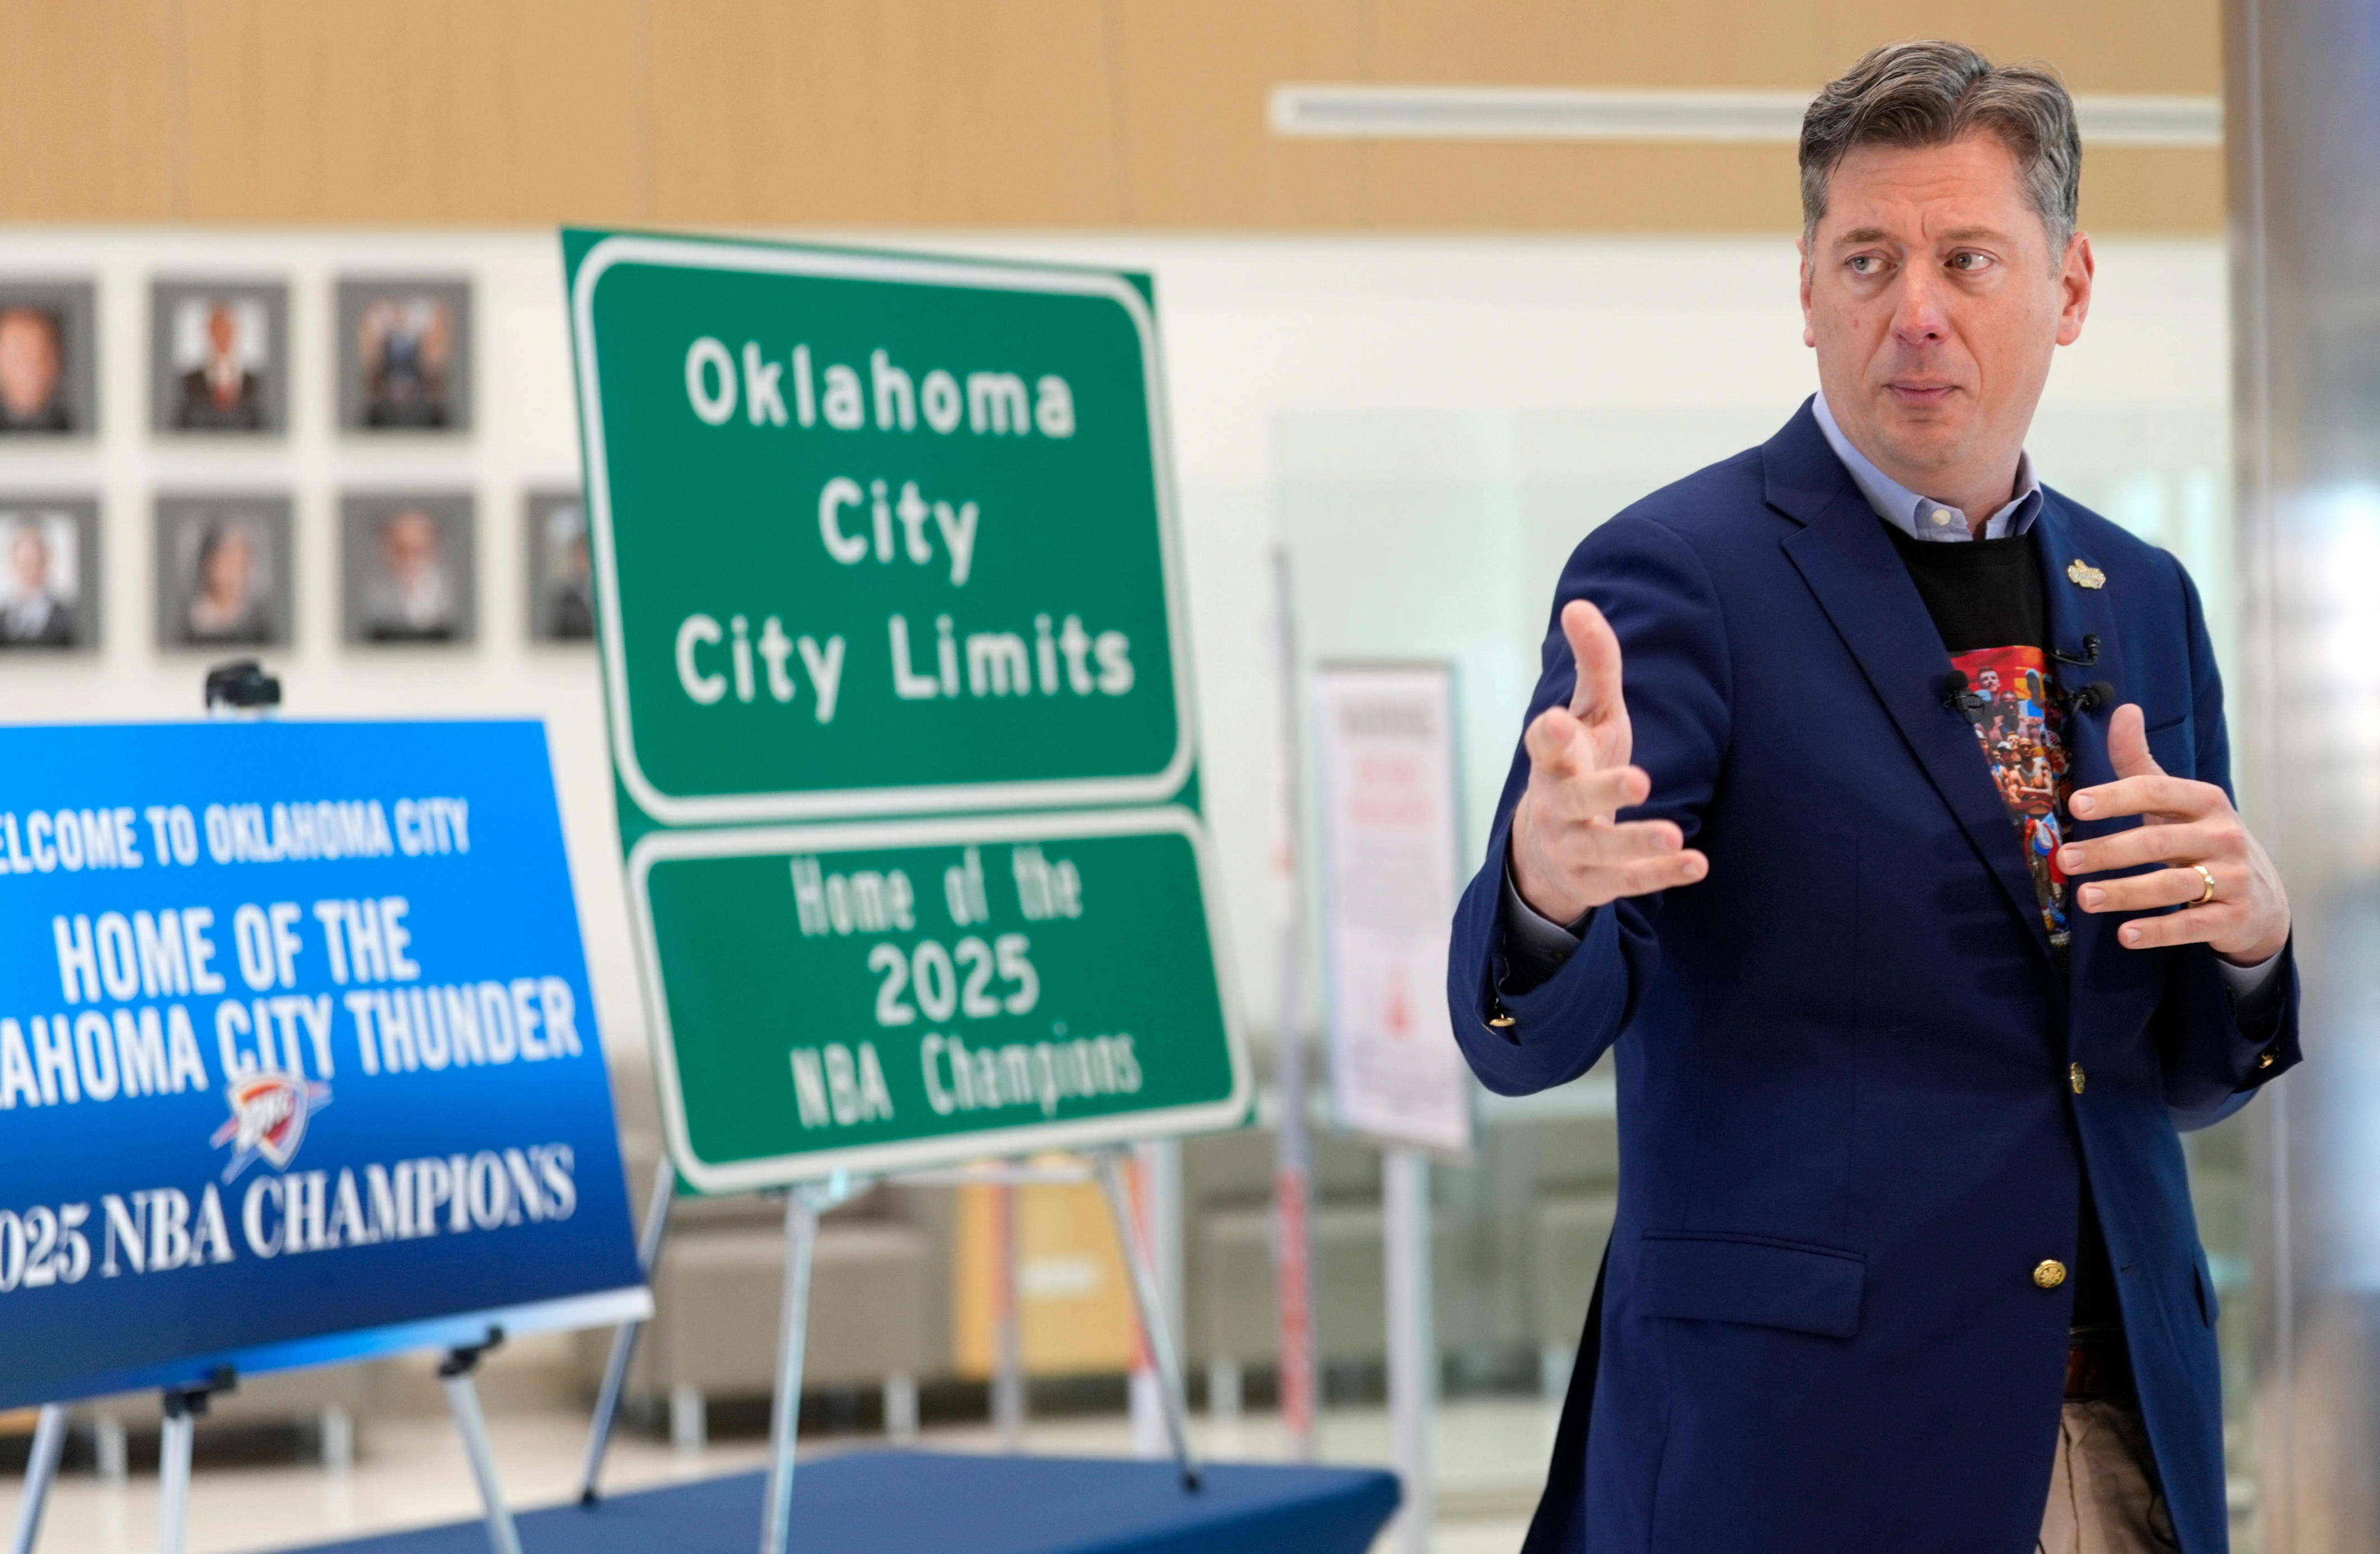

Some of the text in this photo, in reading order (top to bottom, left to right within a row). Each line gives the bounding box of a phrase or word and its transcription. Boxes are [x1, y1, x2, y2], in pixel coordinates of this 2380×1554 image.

[684, 336, 1076, 439] Oklahoma
[817, 477, 980, 586] City
[674, 613, 1136, 724] City Limits
[144, 804, 199, 866] TO
[204, 799, 394, 863] OKLAHOMA
[394, 797, 470, 856] CITY
[790, 843, 1082, 935] Home of the
[52, 896, 421, 1004] HOME OF THE
[868, 932, 1039, 1026] 2025
[0, 976, 582, 1109] AHOMA CITY THUNDER
[790, 1021, 1143, 1128] NBA Champions
[101, 1183, 234, 1278] NBA
[242, 1145, 577, 1258] CHAMPIONS
